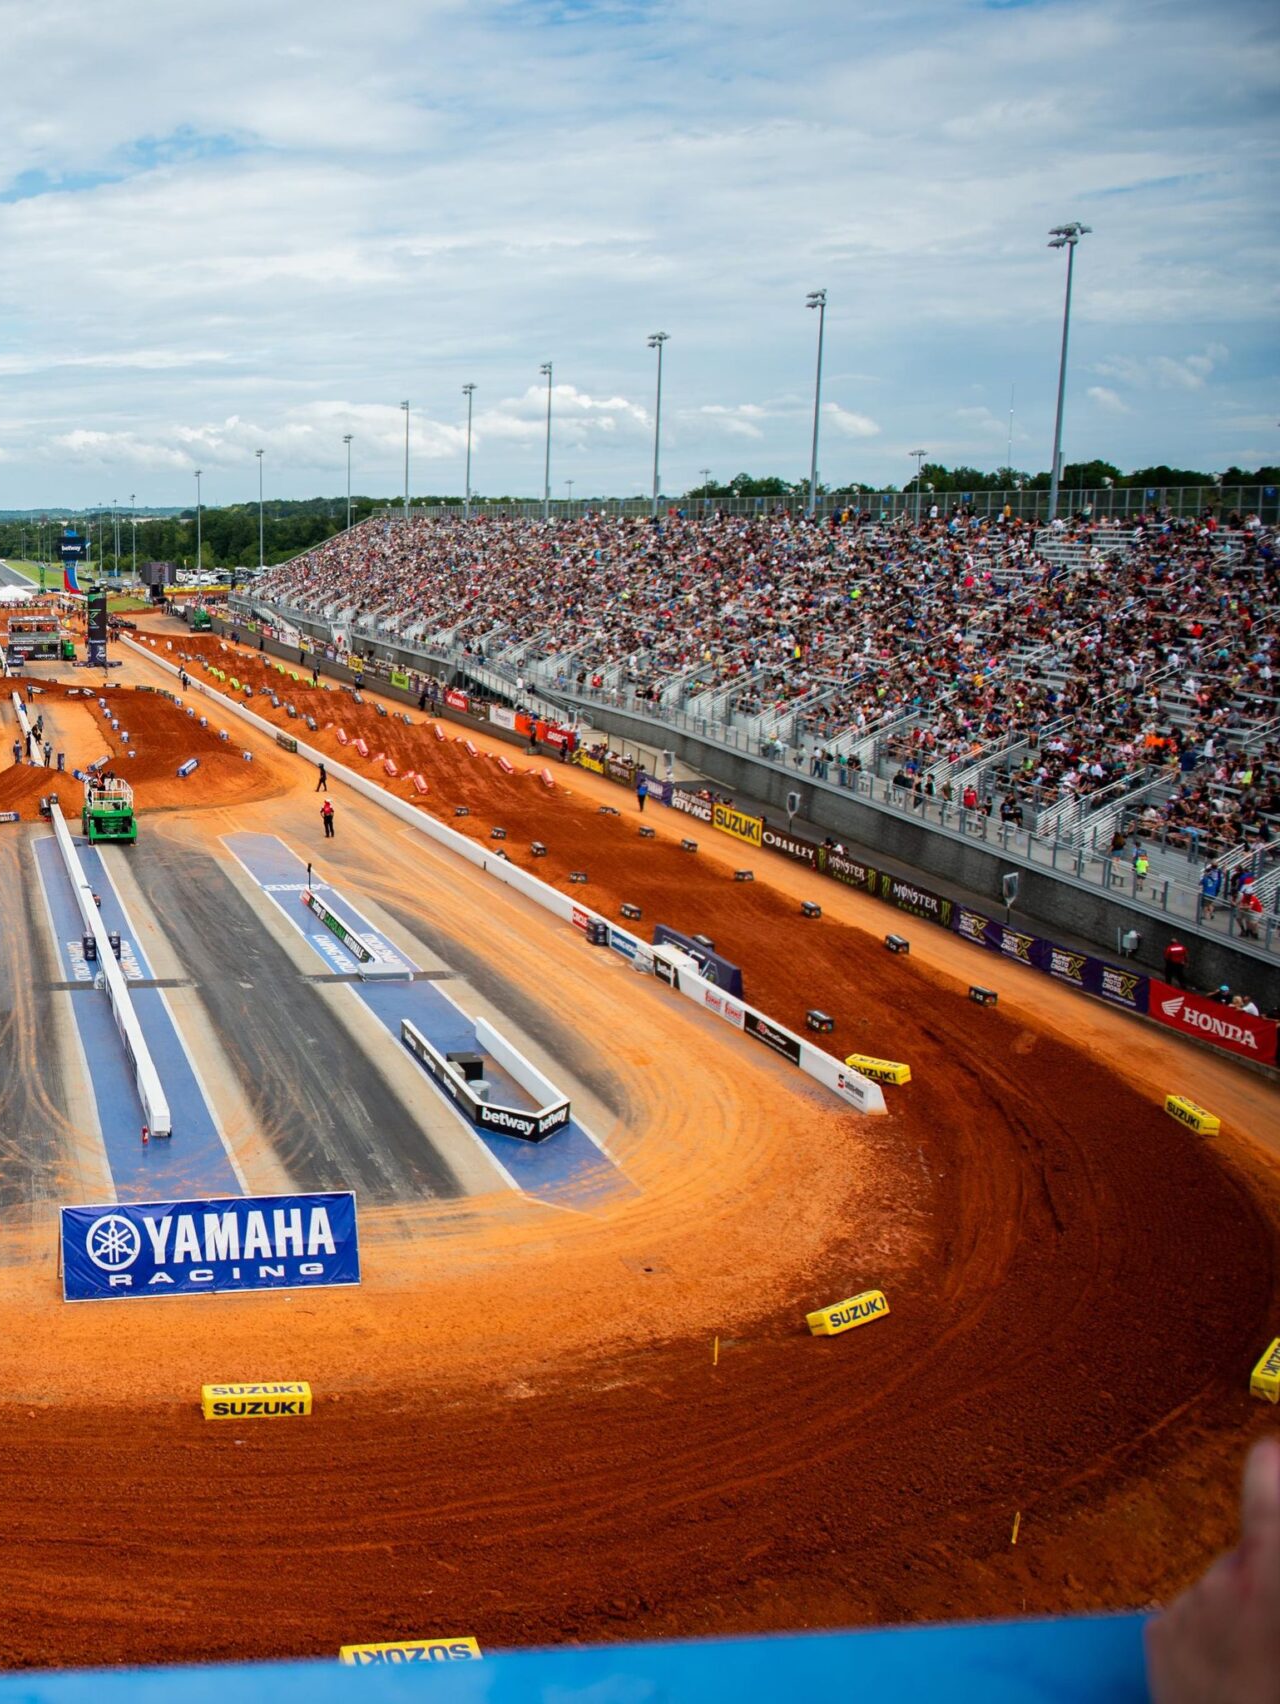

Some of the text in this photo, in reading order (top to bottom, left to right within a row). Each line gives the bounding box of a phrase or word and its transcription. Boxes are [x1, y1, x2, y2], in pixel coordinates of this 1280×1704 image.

[715, 808, 760, 841] SUZUKI
[775, 837, 814, 860] OAKLEY
[828, 854, 866, 881] MONSTER
[892, 881, 939, 914] MONSTER
[1182, 1006, 1258, 1050] HONDA
[482, 1106, 536, 1136] betway
[538, 1107, 568, 1133] betway
[1166, 1101, 1200, 1130] SUZUKI
[142, 1206, 337, 1265] YAMAHA
[109, 1262, 325, 1287] RACING
[829, 1296, 886, 1328] SUZUKI
[211, 1385, 304, 1395] SUZUKI
[213, 1401, 305, 1416] SUZUKI
[351, 1642, 474, 1667] SUZUKI
